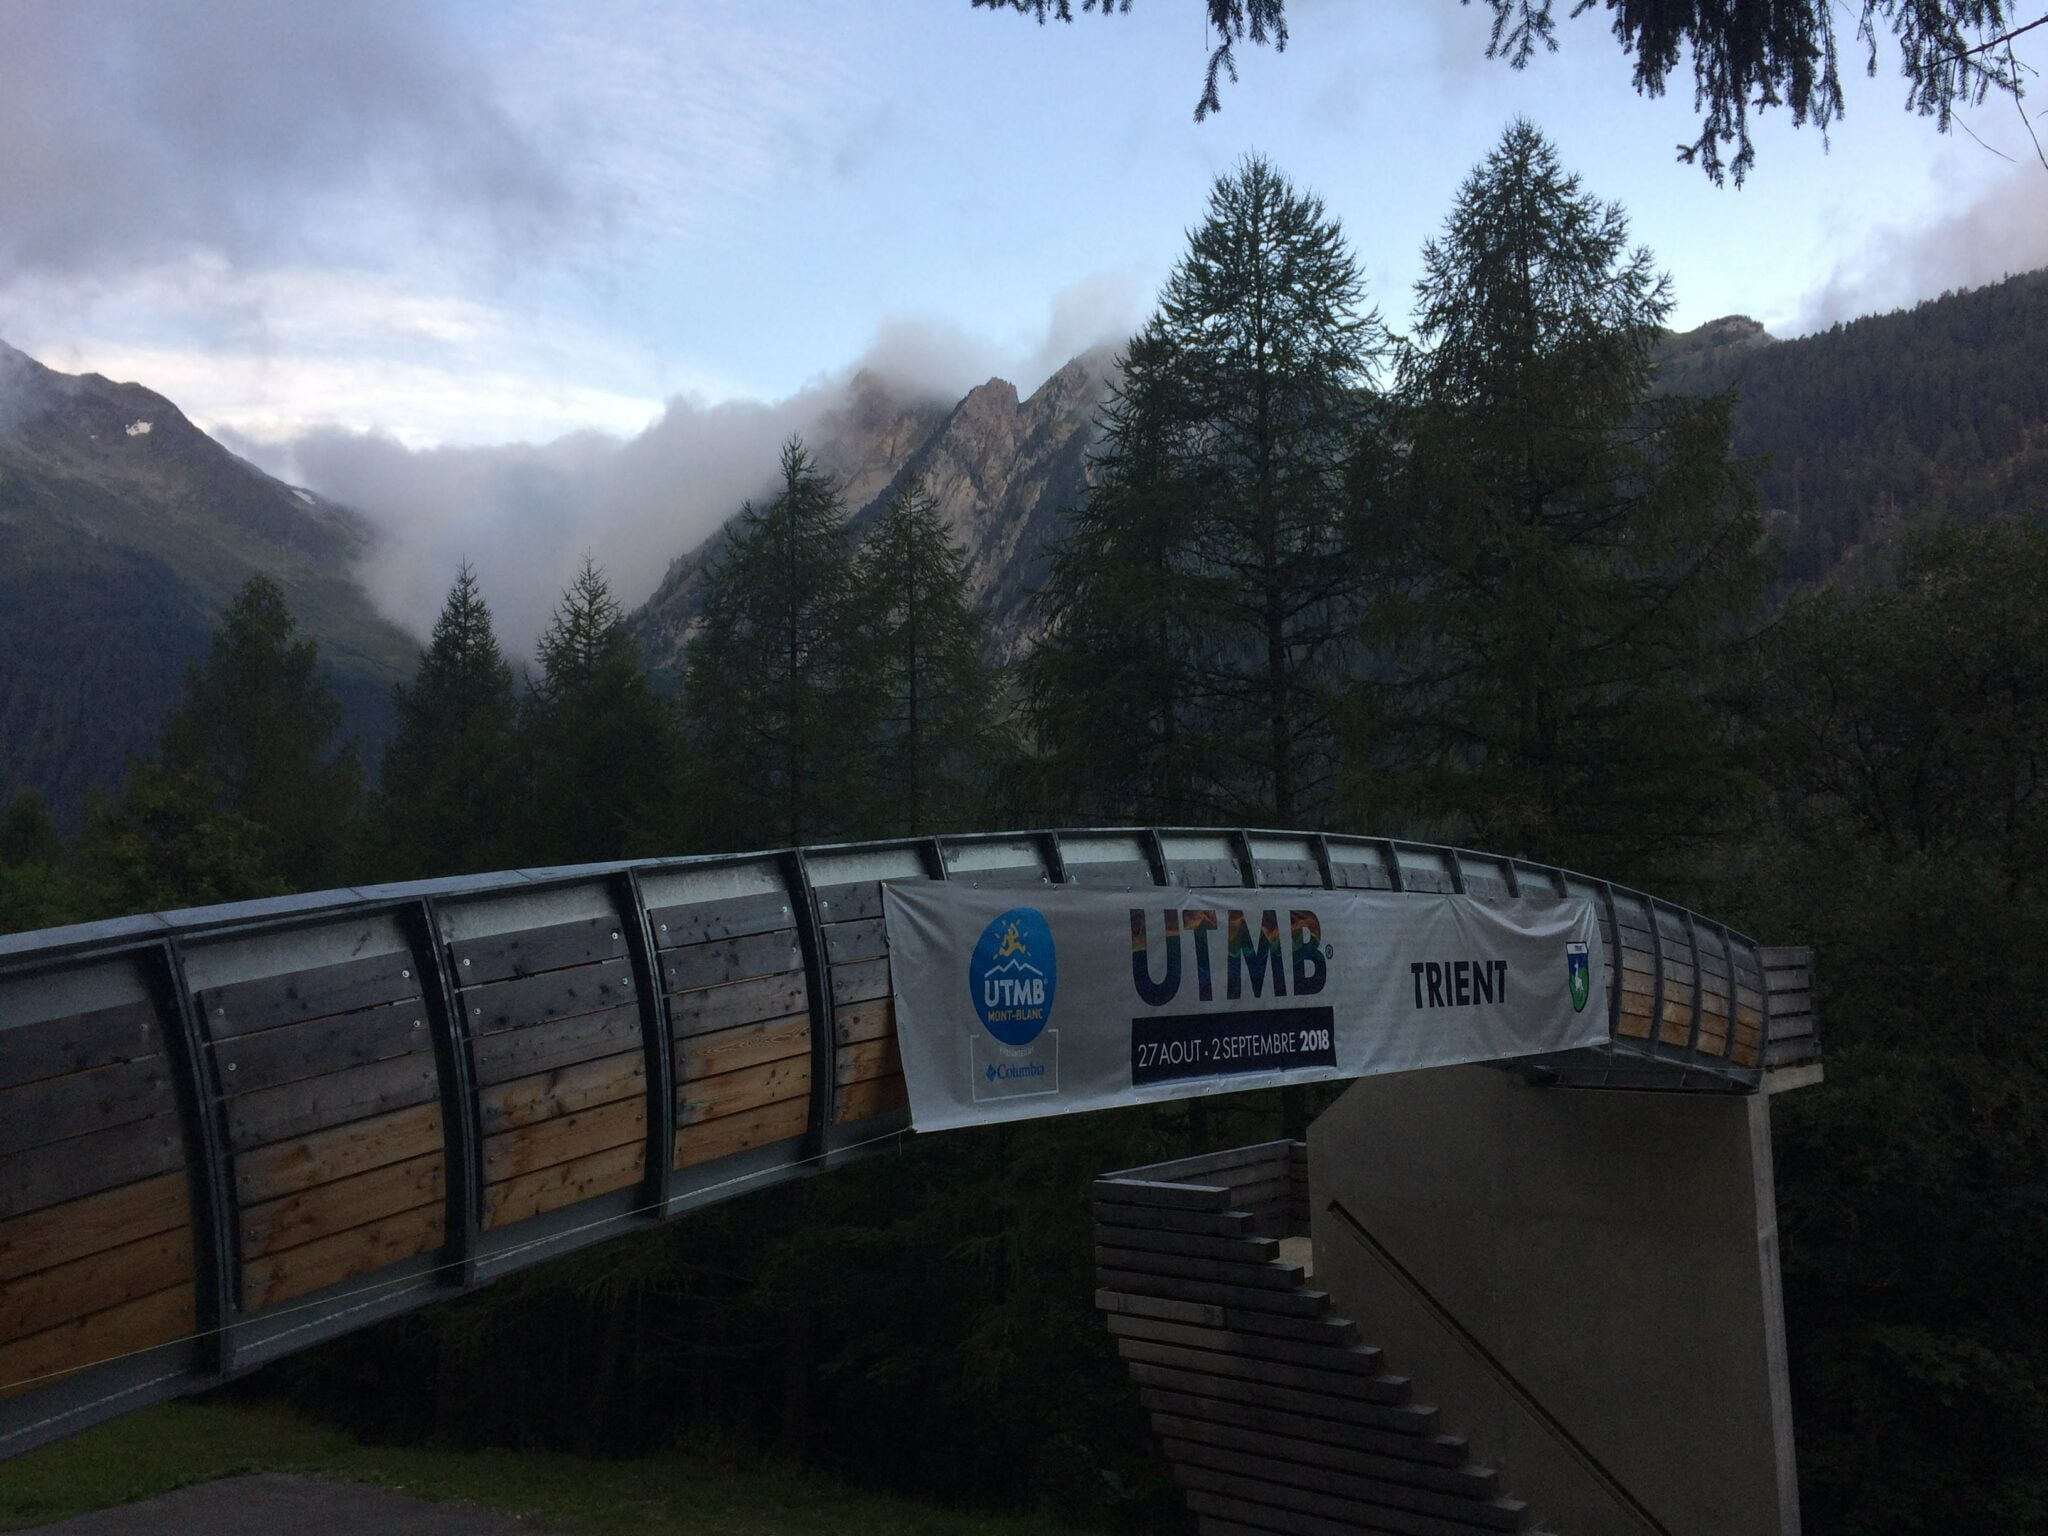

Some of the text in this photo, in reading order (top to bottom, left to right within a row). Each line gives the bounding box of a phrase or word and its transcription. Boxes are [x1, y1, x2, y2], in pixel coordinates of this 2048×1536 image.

[1411, 960, 1508, 1009] TRIENT
[988, 1008, 1043, 1022] MONT-BLANC
[1299, 1029, 1330, 1052] 2018
